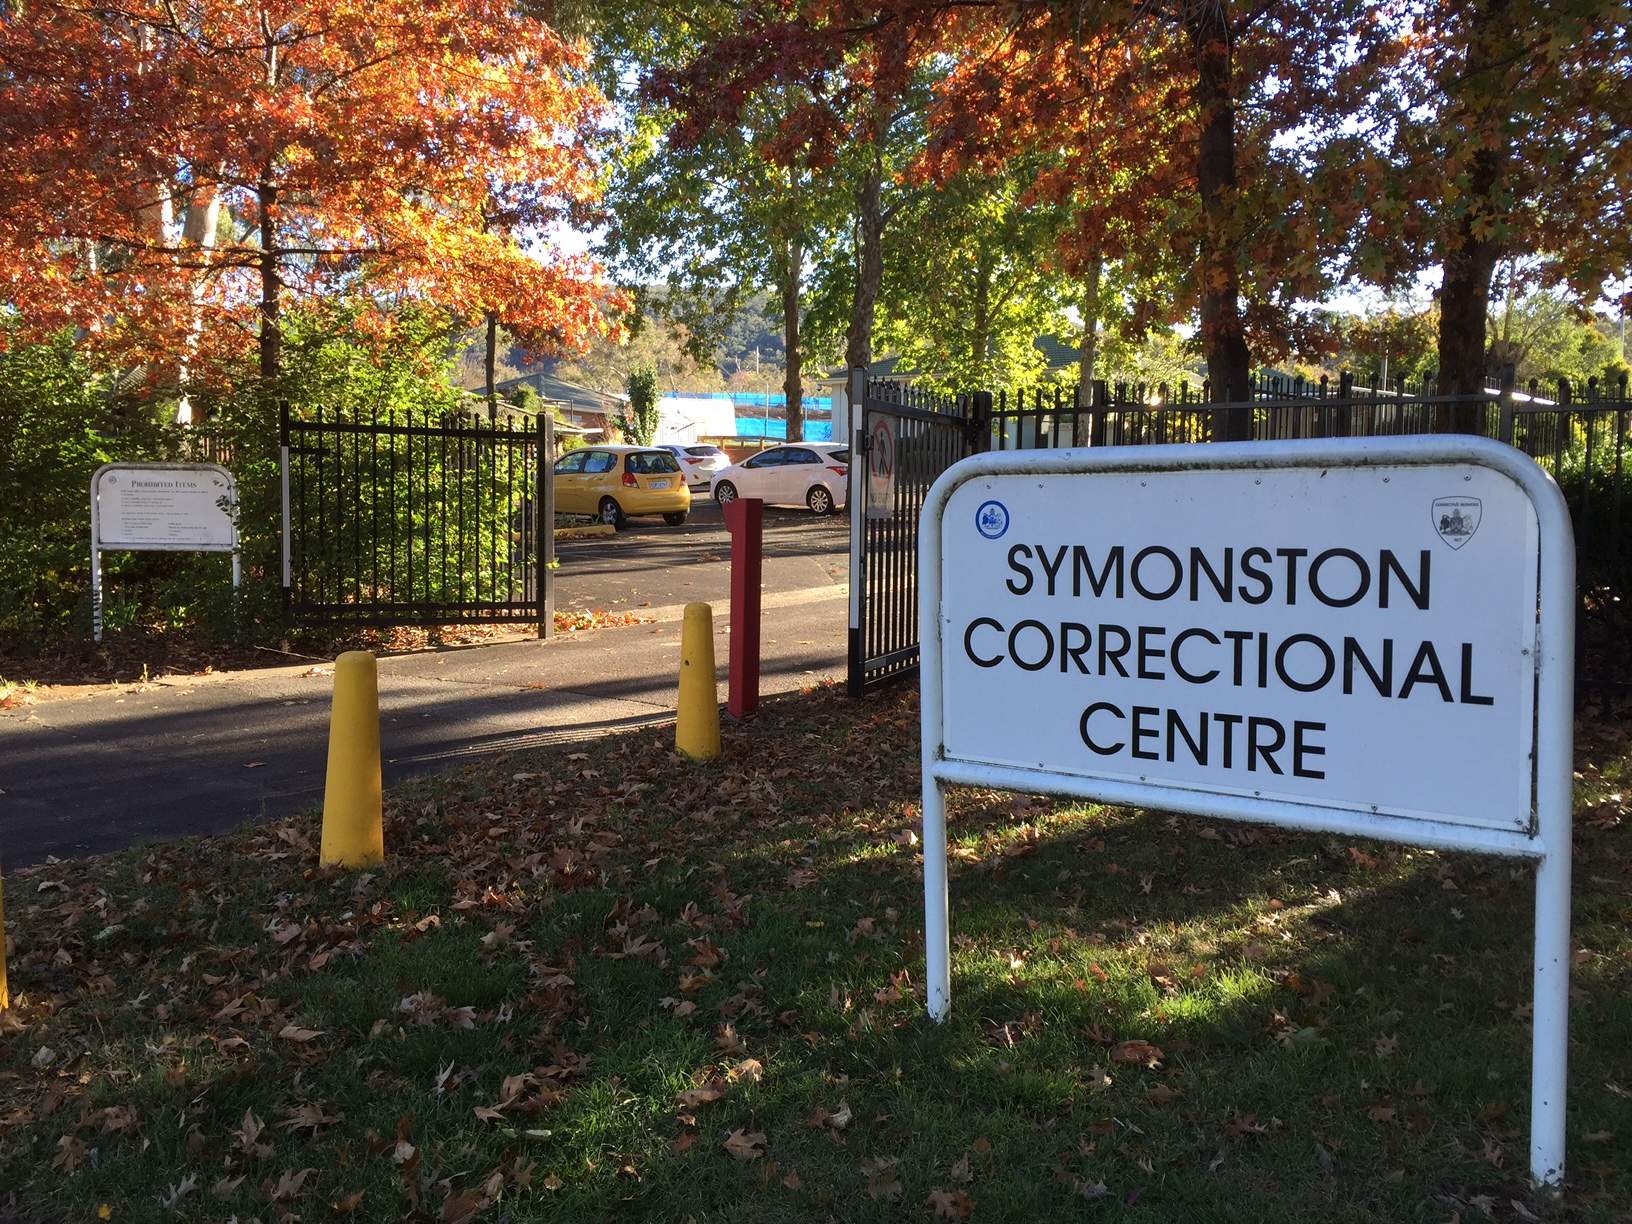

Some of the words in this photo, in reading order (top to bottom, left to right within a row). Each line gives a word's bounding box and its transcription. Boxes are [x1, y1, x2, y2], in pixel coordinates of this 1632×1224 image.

[131, 480, 174, 488] PROHIBITED
[175, 480, 198, 488] ITEMS
[1005, 543, 1431, 611] SYMONSTON
[963, 616, 1494, 706] CORRECTIONAL
[1079, 701, 1326, 780] CENTRE
